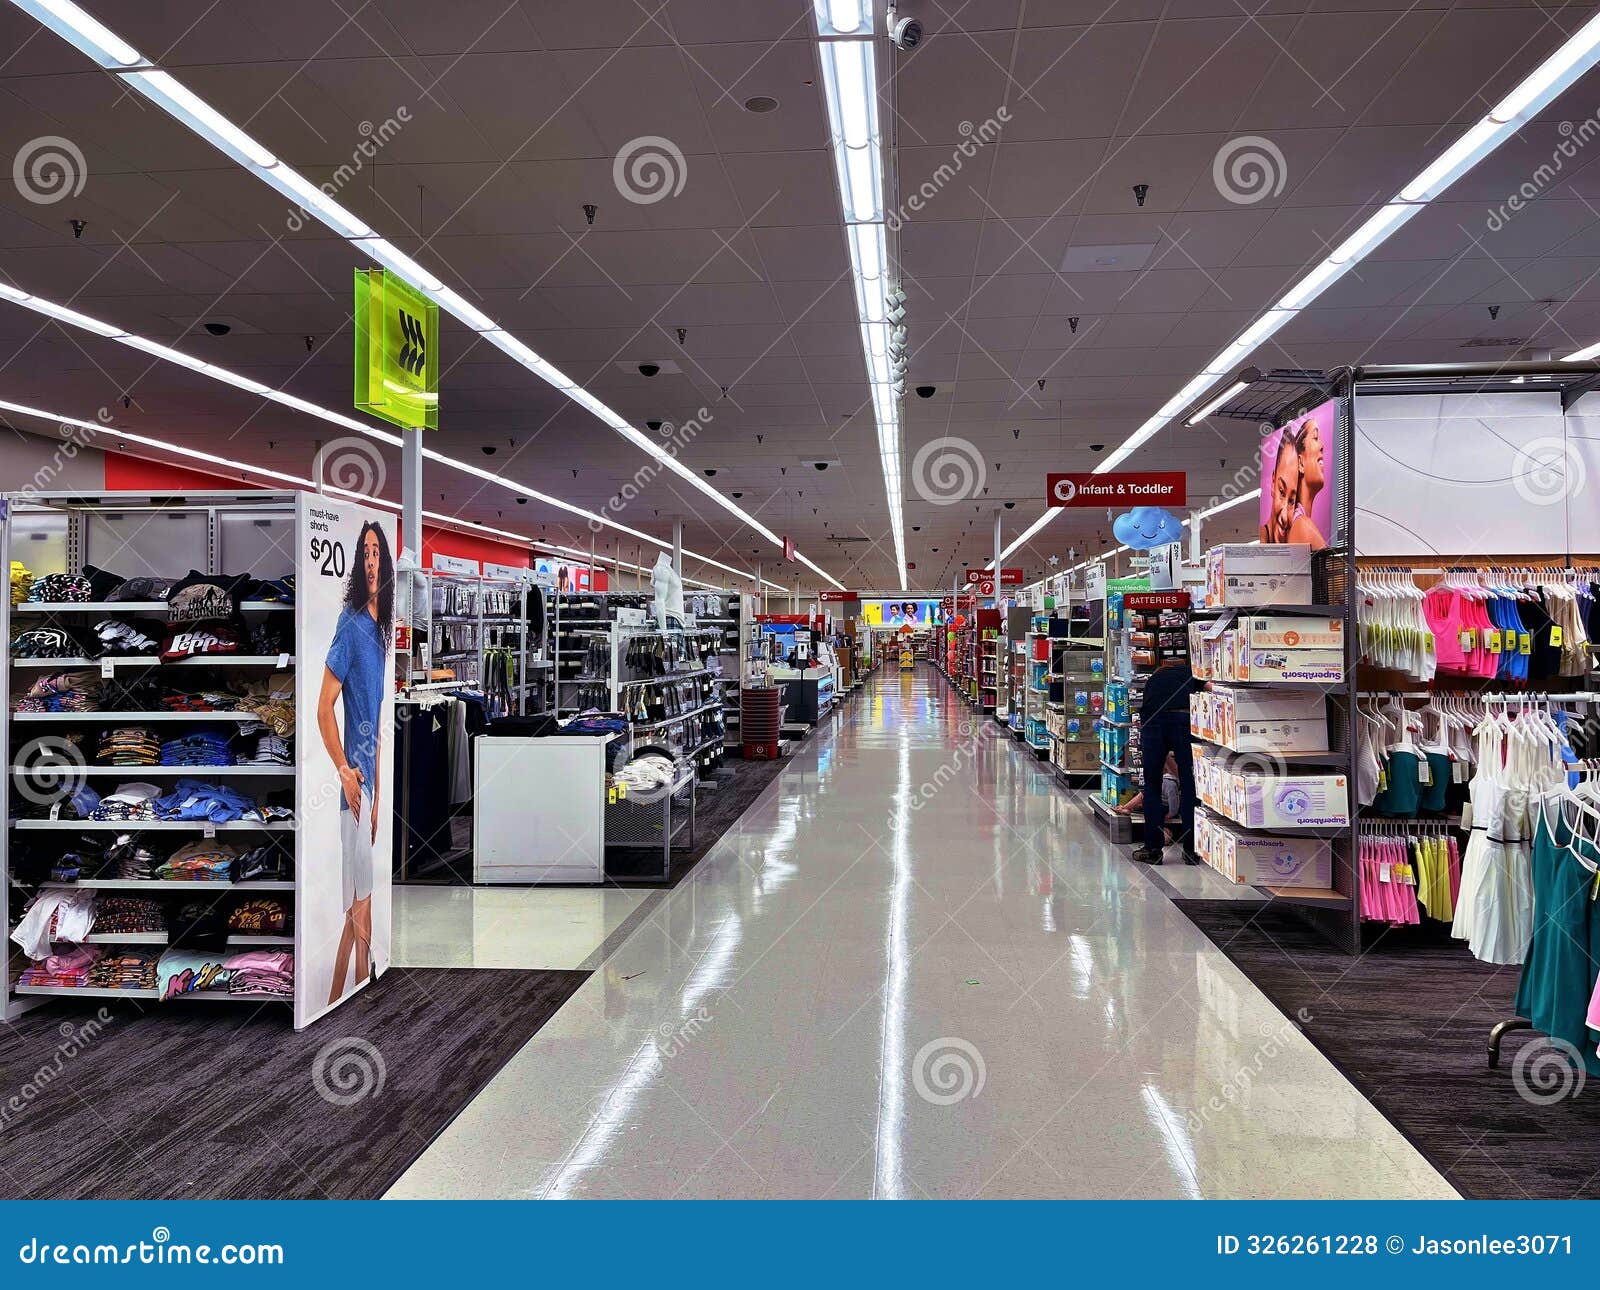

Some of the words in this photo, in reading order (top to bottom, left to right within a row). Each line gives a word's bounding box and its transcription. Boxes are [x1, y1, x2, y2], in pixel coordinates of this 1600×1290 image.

[1079, 484, 1114, 495] Infant
[1116, 484, 1126, 494] &
[1128, 483, 1173, 495] Toddler
[309, 508, 339, 522] must-have
[310, 520, 329, 532] shorts
[310, 535, 346, 578] $20
[1130, 596, 1178, 605] BATTERIES
[1281, 671, 1341, 680] SuperAbsorb
[1296, 816, 1347, 825] SuperAbsorb
